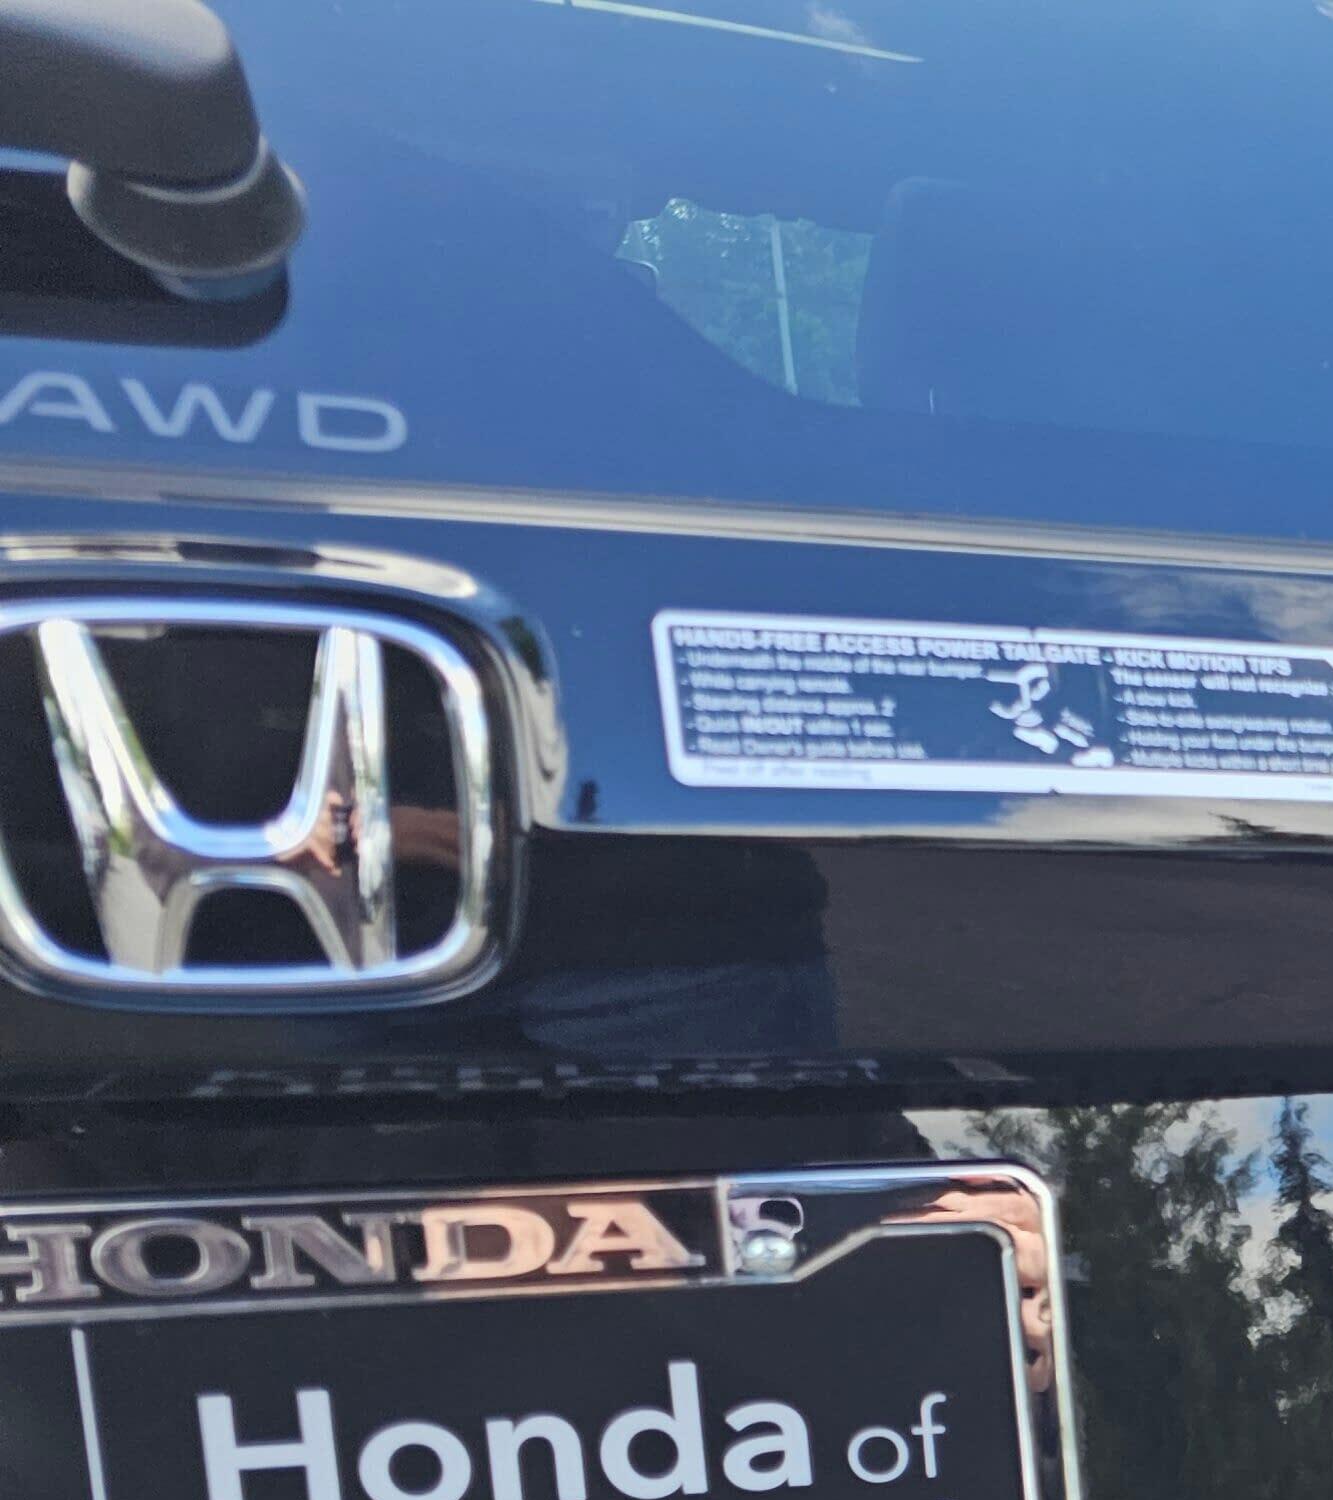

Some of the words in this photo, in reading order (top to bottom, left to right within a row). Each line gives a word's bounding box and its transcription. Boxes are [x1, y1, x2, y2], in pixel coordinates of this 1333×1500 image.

[0, 370, 408, 453] AWD
[673, 626, 822, 652] HANDS-FREE
[824, 633, 916, 656] ACCESS
[917, 637, 1000, 660] POWER
[1001, 641, 1102, 665] TAILGATE
[1114, 648, 1166, 669] KICK
[1166, 651, 1246, 674] MOTION
[1246, 656, 1292, 676] TIPS
[0, 1201, 704, 1304] HONDA
[847, 1392, 948, 1486] of
